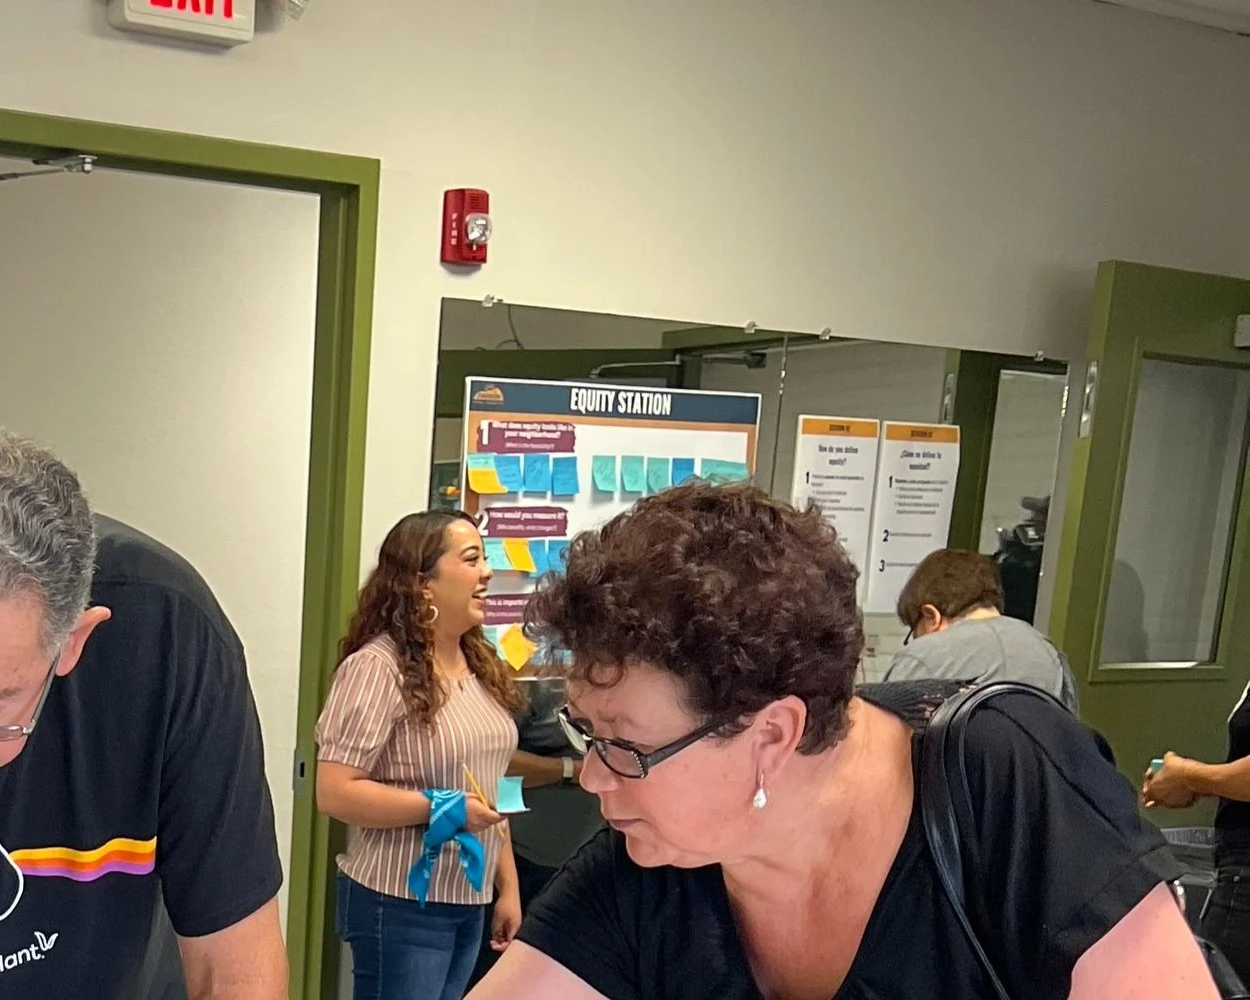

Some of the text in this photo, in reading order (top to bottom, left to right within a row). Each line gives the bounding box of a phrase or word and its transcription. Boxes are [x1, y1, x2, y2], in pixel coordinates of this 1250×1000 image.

[570, 388, 672, 416] EQUITY STATION
[481, 420, 489, 445] 1
[883, 529, 889, 542] 2
[879, 560, 885, 572] 3
